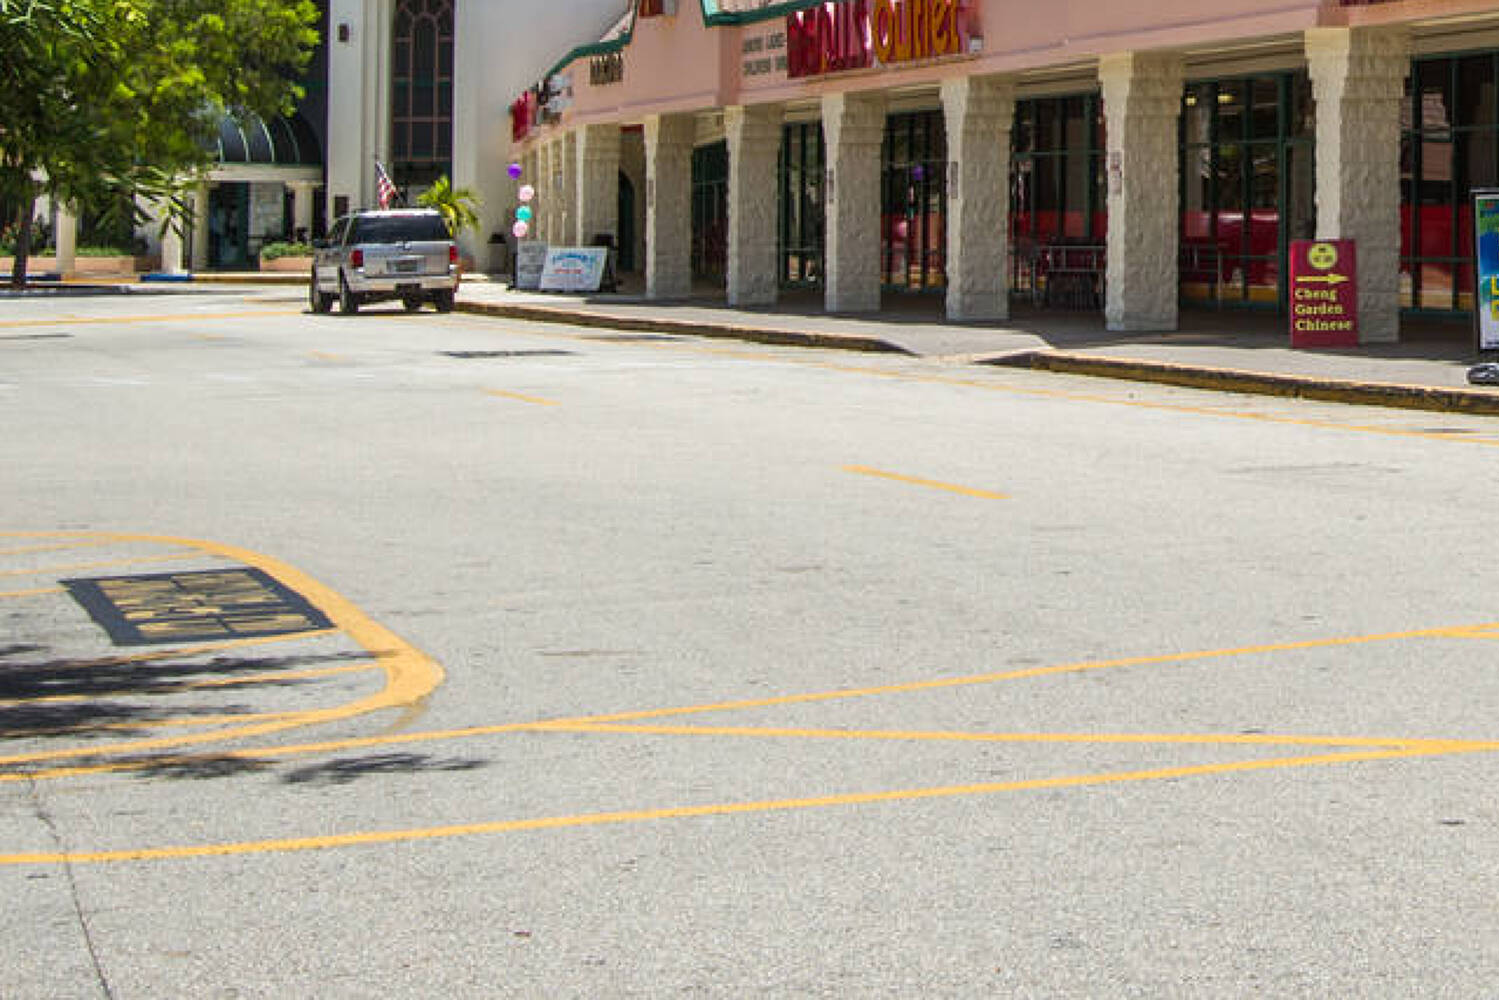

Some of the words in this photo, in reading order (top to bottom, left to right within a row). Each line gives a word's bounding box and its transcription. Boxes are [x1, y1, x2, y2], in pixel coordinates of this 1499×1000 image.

[1294, 287, 1337, 303] Cheng
[1294, 302, 1344, 316] Garden
[1294, 318, 1352, 332] Chinese
